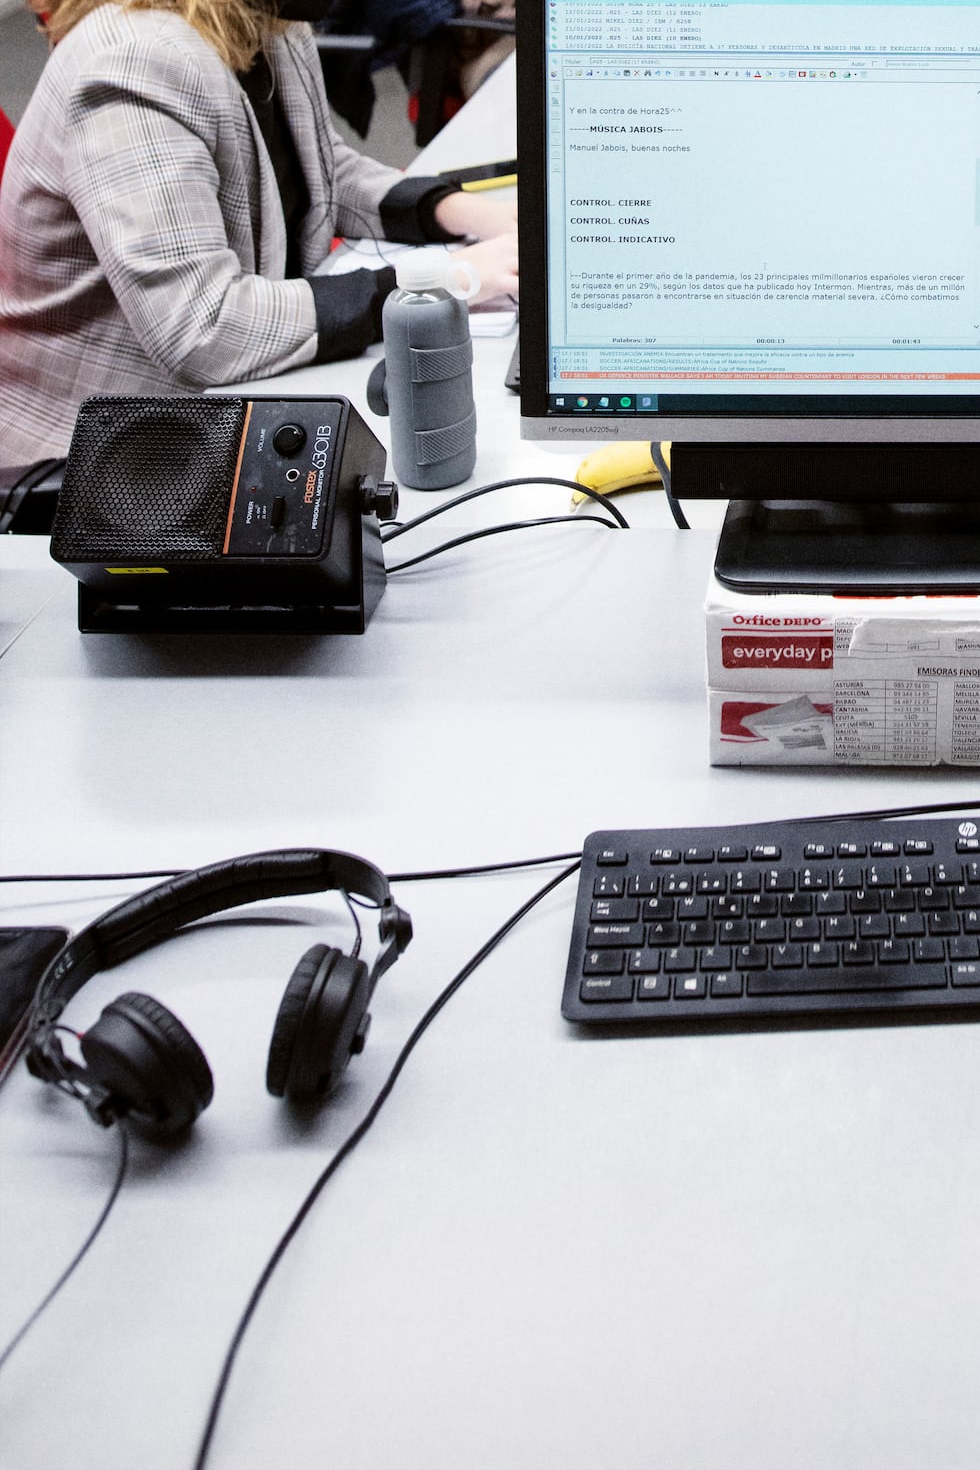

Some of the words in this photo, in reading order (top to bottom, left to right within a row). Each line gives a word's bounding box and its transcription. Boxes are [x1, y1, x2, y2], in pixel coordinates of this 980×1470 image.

[589, 106, 597, 114] la
[598, 106, 625, 114] contra
[627, 106, 638, 114] de
[600, 143, 628, 152] Jabois,
[662, 144, 690, 152] noches
[618, 216, 649, 224] CUÑAS
[616, 271, 623, 279] el
[625, 271, 653, 281] primer
[695, 272, 737, 282] pandemia,
[740, 272, 751, 280] los
[754, 272, 763, 280] 23
[766, 272, 809, 282] principales
[869, 273, 909, 282] españoles
[911, 273, 937, 281] vieron
[582, 281, 611, 291] riqueza
[639, 282, 660, 290] 29%,
[662, 282, 686, 291] según
[756, 282, 794, 292] publicado
[796, 282, 811, 292] hoy
[857, 283, 894, 291] Mientras,
[570, 291, 581, 299] de
[583, 293, 619, 301] personas
[621, 293, 654, 301] pasaron
[763, 292, 774, 300] de
[775, 292, 809, 300] carencia
[811, 292, 845, 300] material
[880, 292, 908, 302] ¿Cómo
[570, 301, 578, 309] la
[580, 301, 632, 311] desigualdad?
[558, 426, 584, 434] Compaq
[257, 428, 266, 452] VOLUME
[311, 425, 332, 469] 6301B
[316, 470, 325, 497] MONITOR
[246, 501, 254, 524] POWER
[312, 497, 321, 530] PERSONAL
[783, 617, 825, 626] DEPO
[733, 643, 816, 661] everyday
[917, 667, 958, 675] EMISORAS
